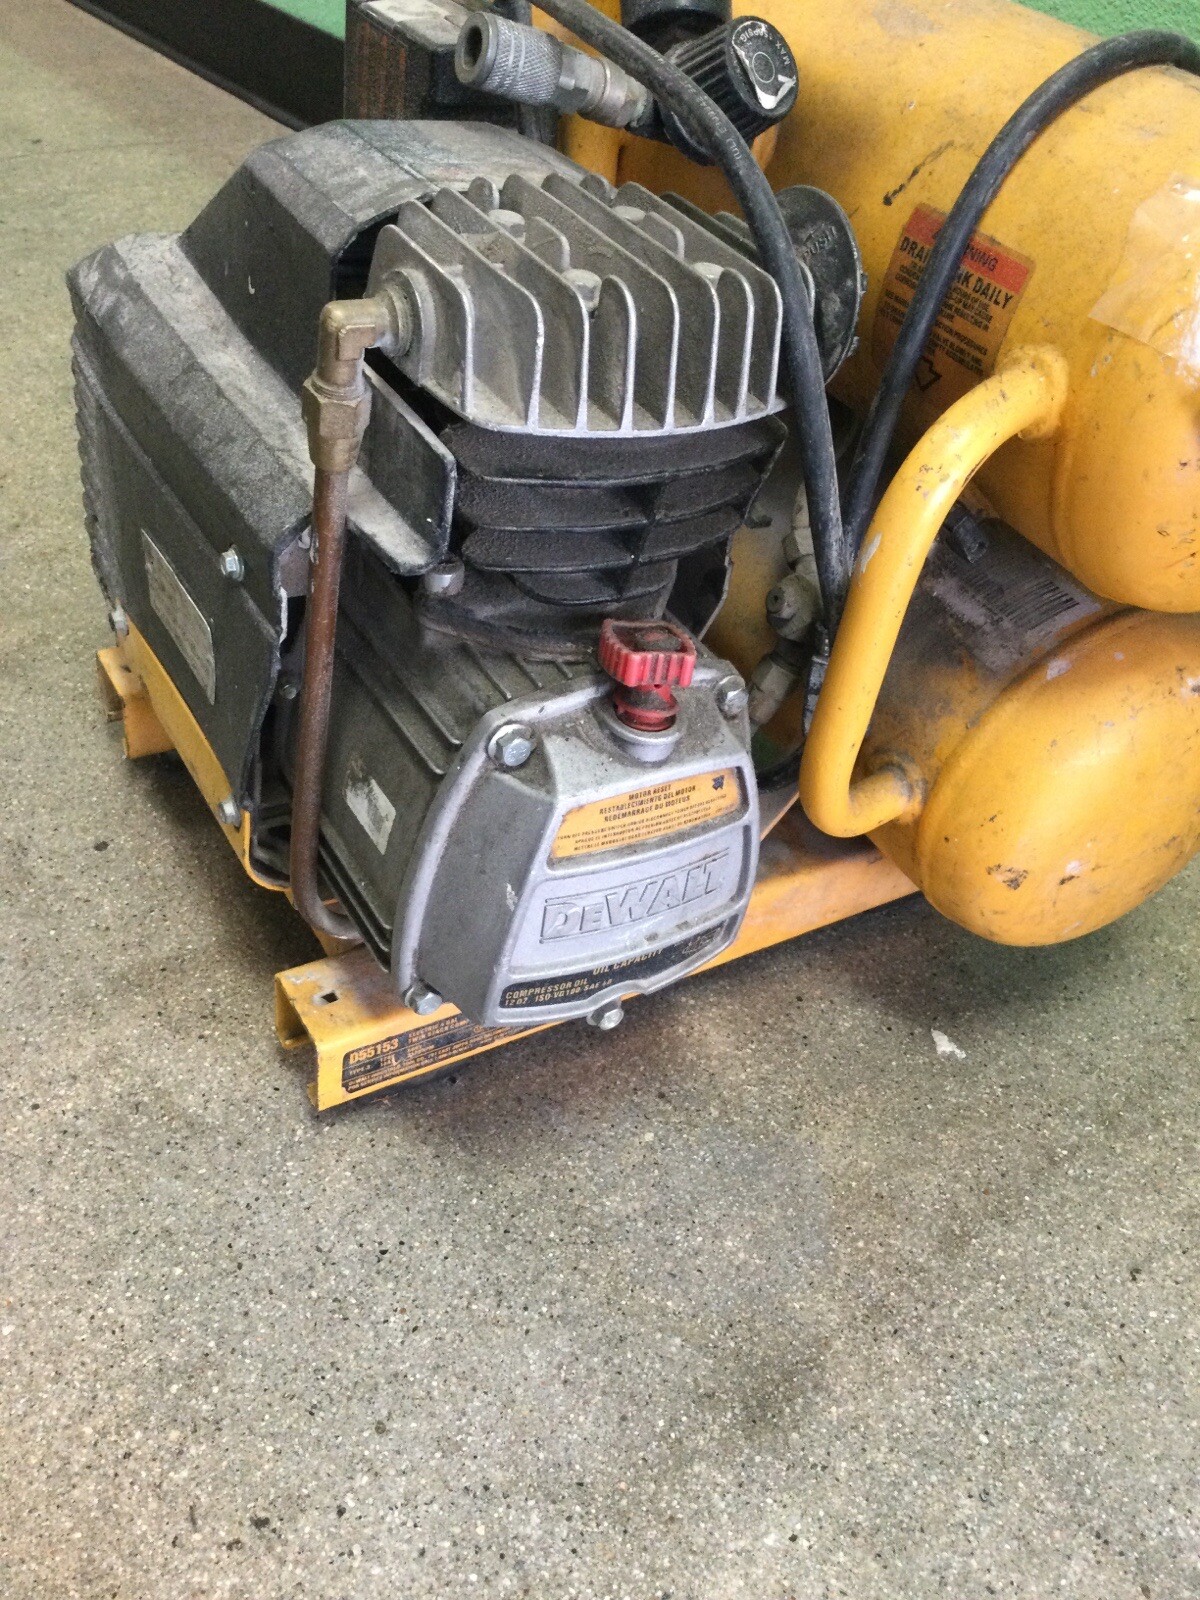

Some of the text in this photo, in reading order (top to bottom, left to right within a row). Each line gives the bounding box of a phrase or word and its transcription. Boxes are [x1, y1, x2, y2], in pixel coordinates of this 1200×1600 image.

[900, 236, 930, 263] DRAI
[973, 276, 1014, 310] DAILY
[628, 783, 672, 800] MOTOR RESET
[663, 790, 676, 801] DEL
[675, 785, 697, 797] MOTOR
[654, 800, 665, 811] DU
[592, 948, 664, 976] OIL CAPACITY
[505, 978, 589, 1000] COMPRESSOR OIL
[583, 980, 602, 992] SAE
[350, 1037, 399, 1064] D55153
